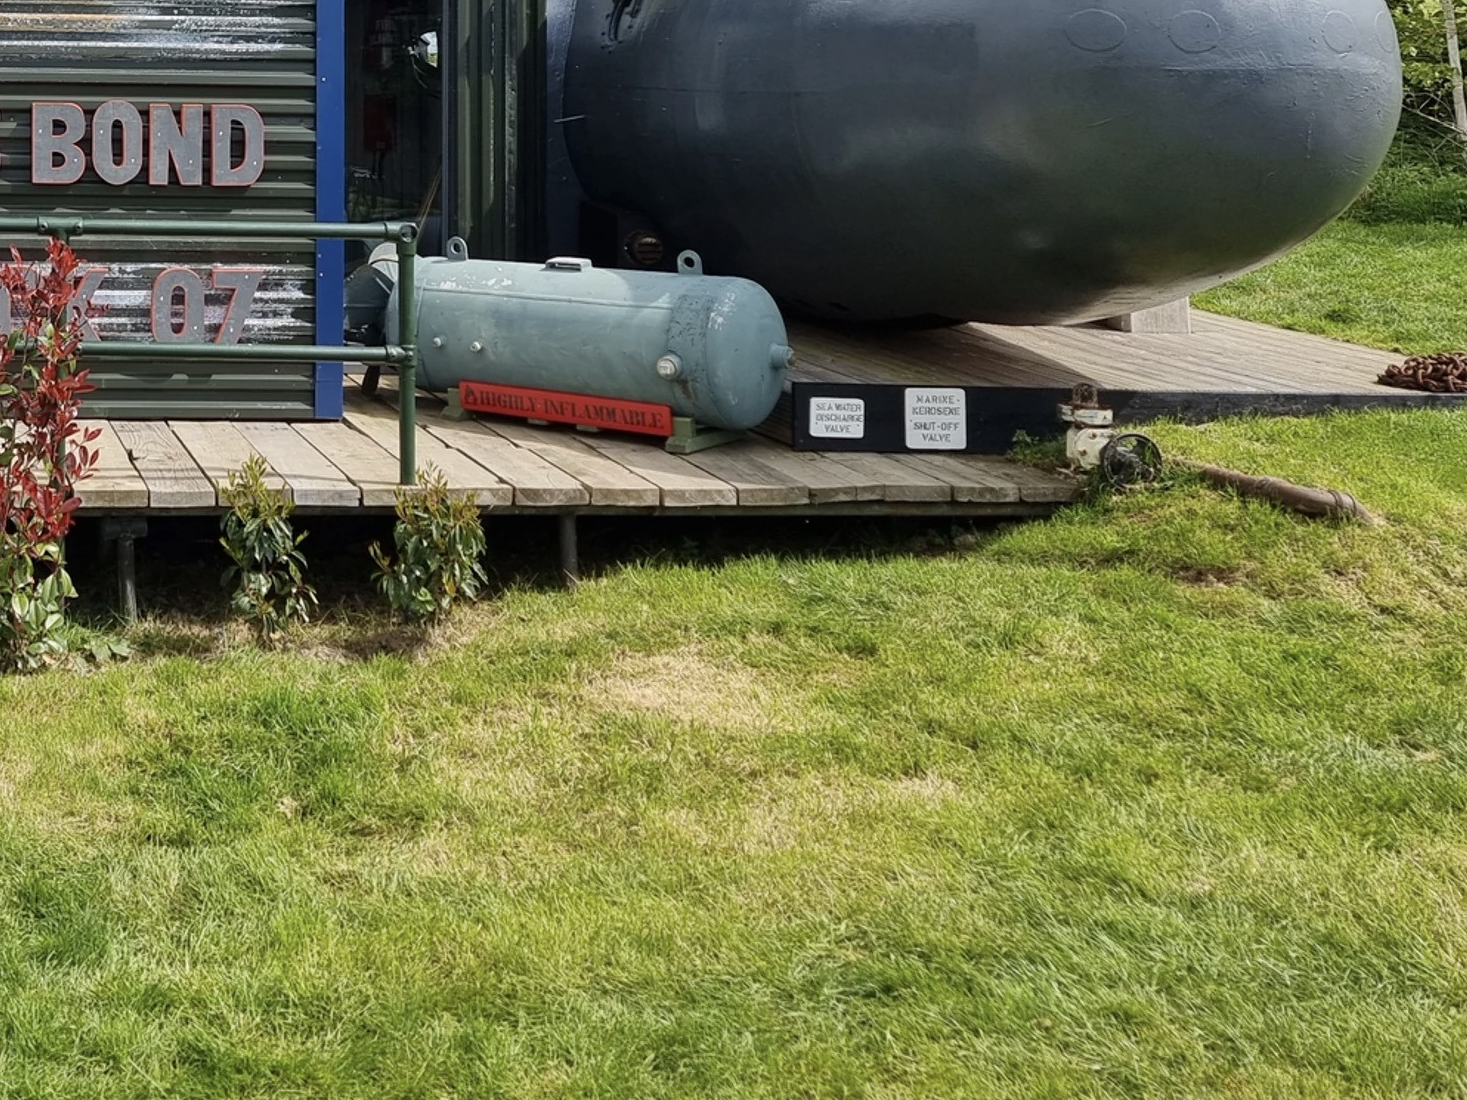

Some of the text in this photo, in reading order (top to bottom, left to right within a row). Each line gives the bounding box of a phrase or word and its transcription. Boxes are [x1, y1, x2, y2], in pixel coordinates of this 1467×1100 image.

[32, 100, 265, 187] BOND
[151, 267, 264, 344] 07
[479, 390, 664, 430] HIGHLY INFLAMMABLE
[824, 424, 852, 433] VALVE
[922, 433, 951, 443] VALVE
